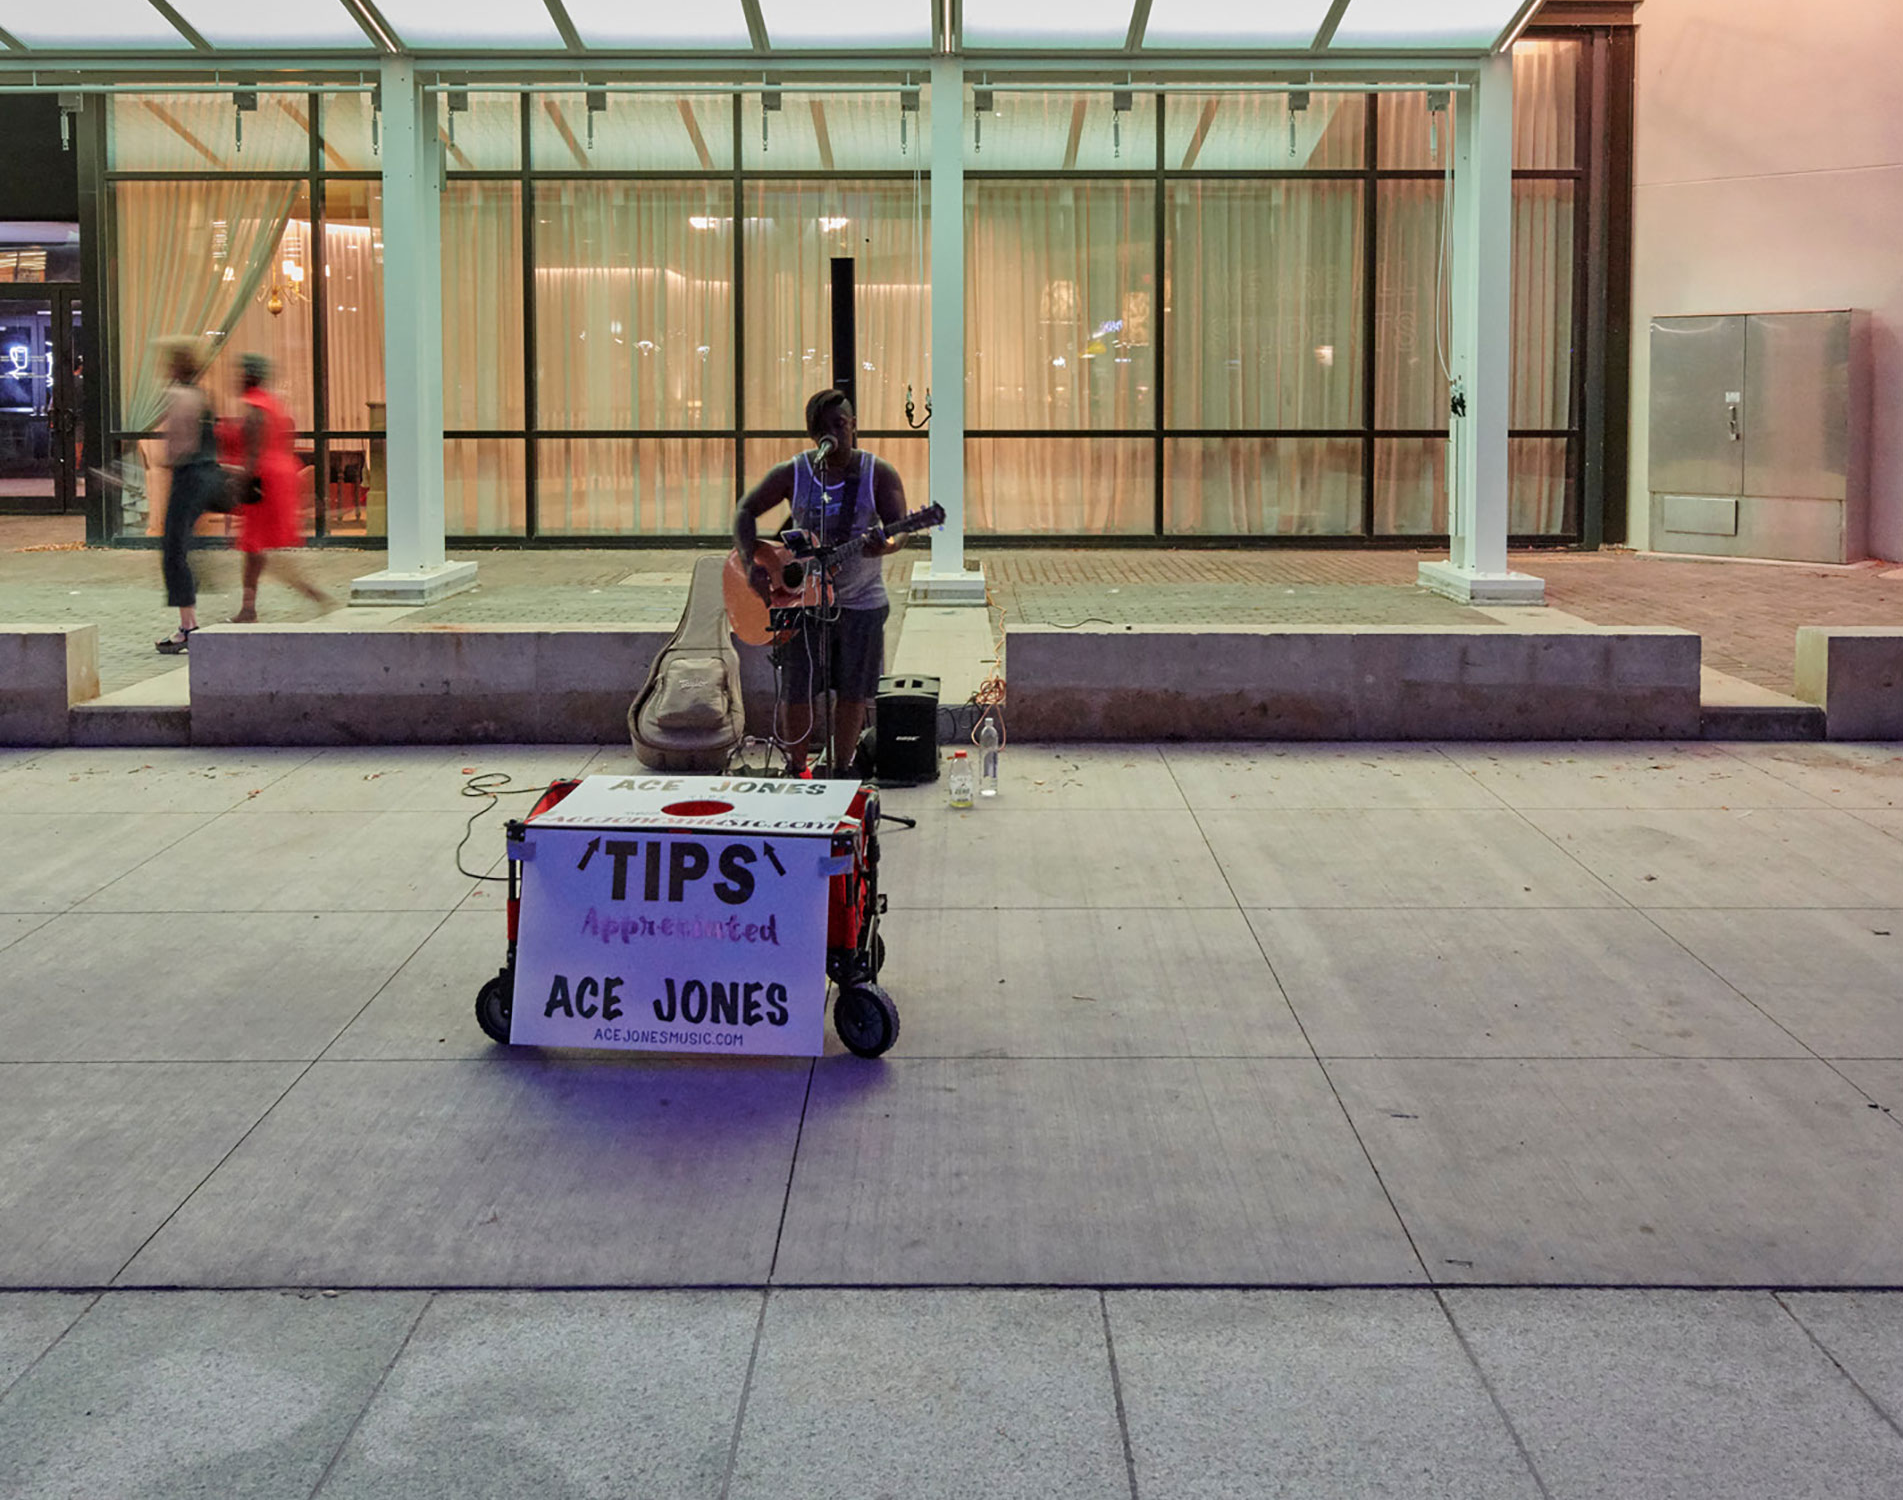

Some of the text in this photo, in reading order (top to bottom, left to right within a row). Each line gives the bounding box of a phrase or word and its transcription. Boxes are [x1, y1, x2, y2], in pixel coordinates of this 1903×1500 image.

[608, 779, 828, 796] ACE JONES
[604, 840, 758, 906] TIPS
[580, 906, 780, 946] Appreciated
[543, 974, 789, 1027] ACE JONES
[593, 1028, 744, 1046] ACEJONESMUSIC.COM
